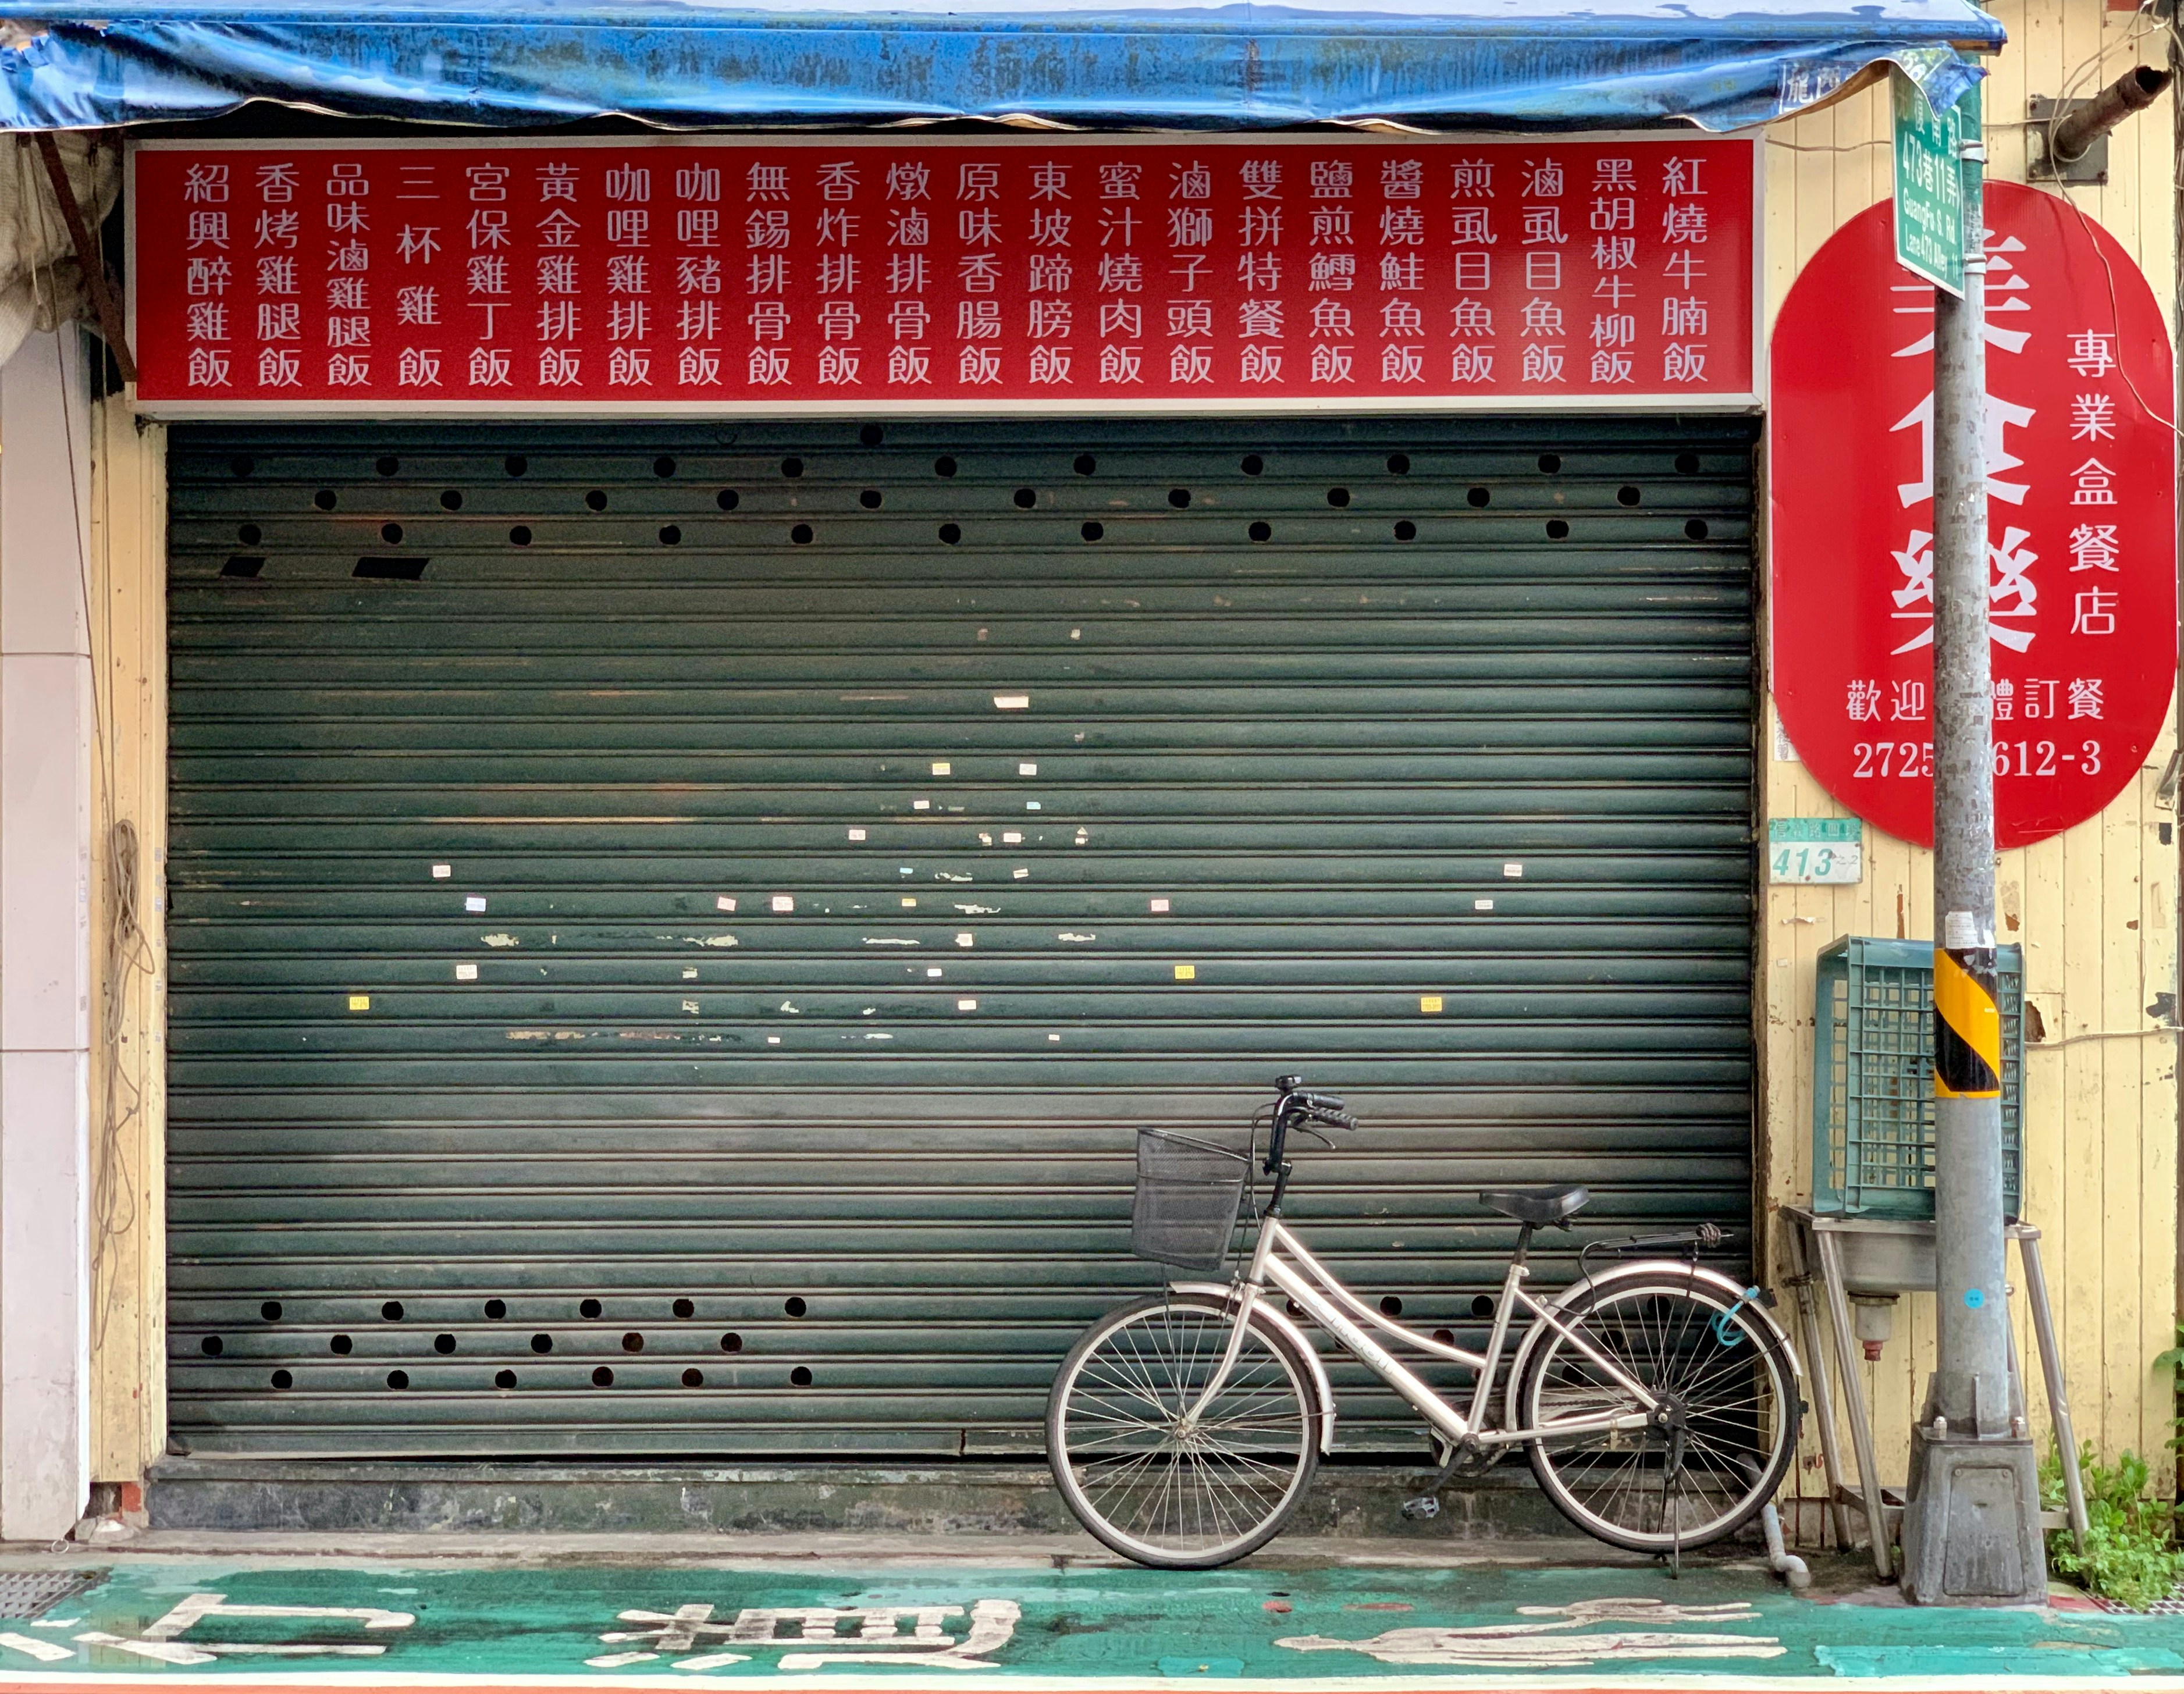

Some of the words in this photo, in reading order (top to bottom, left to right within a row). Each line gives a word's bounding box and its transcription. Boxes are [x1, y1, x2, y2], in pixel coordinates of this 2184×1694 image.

[184, 163, 233, 387] 紹興醉雞飯
[254, 162, 303, 387] 香烤雞腿飯
[326, 163, 372, 387] 品味滷雞腿飯
[396, 166, 443, 387] 三杯雞飯
[465, 162, 513, 387] 宮保雞丁飯
[535, 162, 584, 387] 黃金雞排飯
[606, 162, 653, 386] 咖哩雞排飯
[675, 162, 723, 386] 咖哩豬排飯
[745, 161, 792, 386] 無錫排骨飯
[816, 161, 862, 386] 香炸排骨飯
[885, 161, 932, 385] 燉滷排骨飯
[956, 163, 1003, 385] 原味香腸飯
[1027, 161, 1073, 385] 東坡蹄膀飯
[1098, 161, 1144, 385] 蜜汁燒肉飯
[1166, 160, 1215, 384] 滷獅子頭飯
[1237, 159, 1285, 384] 雙拼特餐飯
[1308, 159, 1356, 383] 鹽煎鱈魚飯
[1379, 159, 1426, 383] 醬燒鮭魚飯
[1449, 158, 1498, 383] 煎虱目魚飯
[1520, 157, 1568, 383] 滷虱目魚飯
[1589, 158, 1638, 384] 黑胡椒牛柳飯
[1662, 156, 1709, 382] 紅燒牛腩飯
[1902, 131, 1957, 207] 473巷11弄
[1905, 223, 1920, 257] Lane
[1920, 233, 1932, 265] 473
[1933, 242, 1948, 280] Alley
[1952, 252, 1959, 281] 11
[2066, 328, 2119, 635] 專業盒餐店
[1845, 677, 2104, 722] 歡迎體訂餐
[1772, 848, 1832, 877] 413
